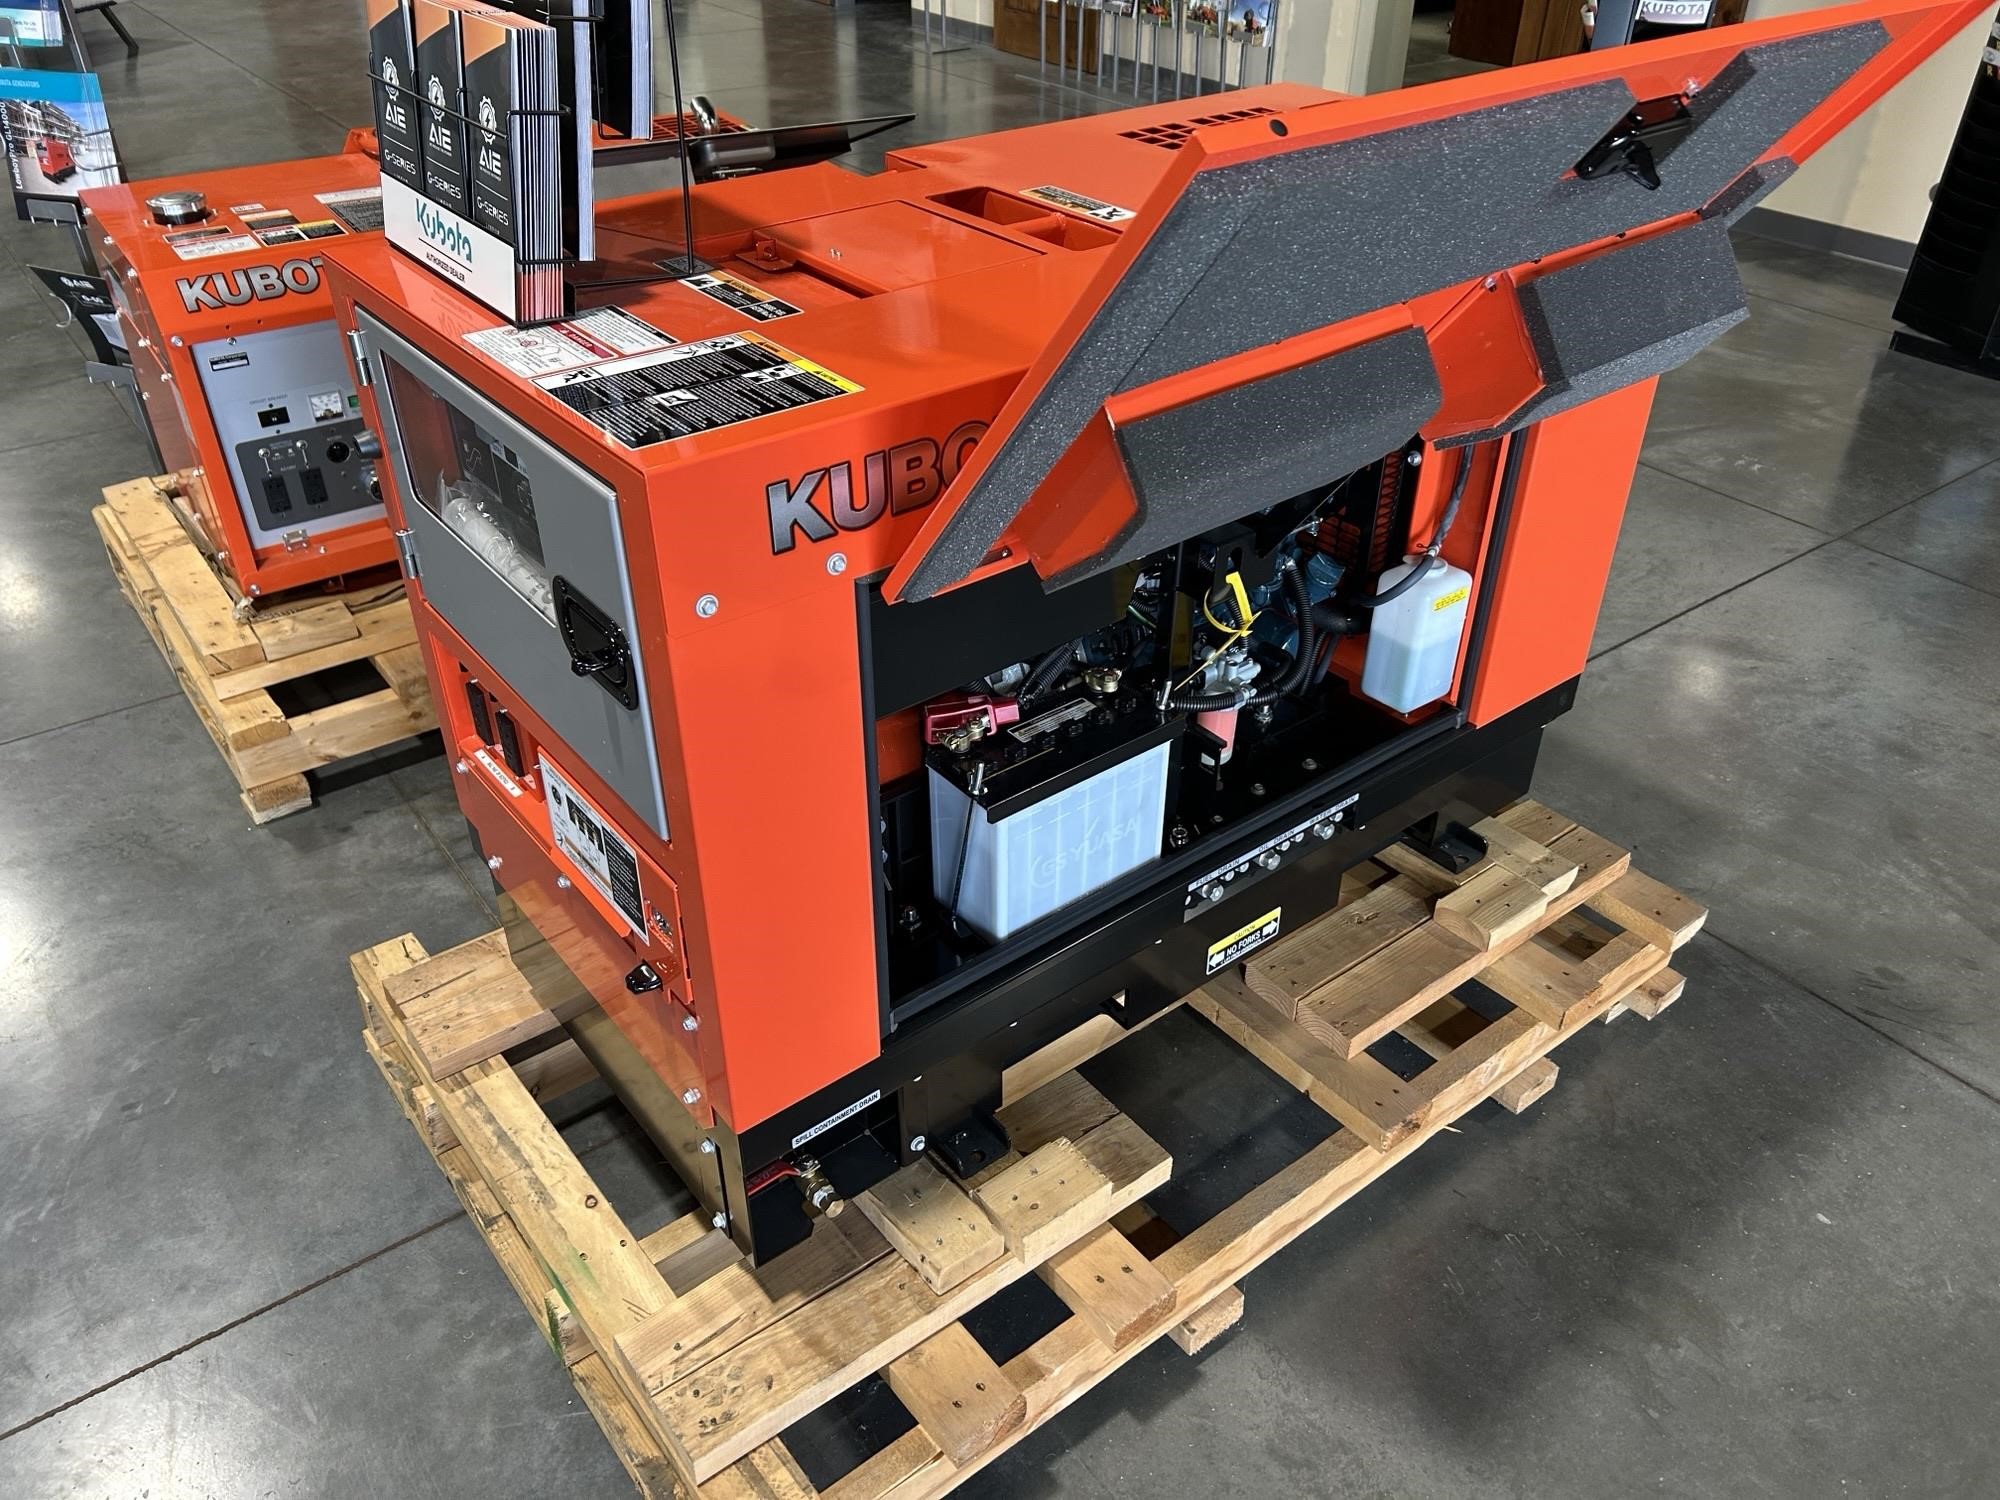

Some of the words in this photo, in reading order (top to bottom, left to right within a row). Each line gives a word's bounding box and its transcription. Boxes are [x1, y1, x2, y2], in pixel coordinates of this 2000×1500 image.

[1641, 1, 1706, 16] KUBOTA
[384, 149, 417, 175] G-SERIES
[426, 171, 462, 199] G-SERIES
[476, 196, 509, 226] G-SERIES
[415, 197, 473, 263] Kubota
[176, 256, 324, 314] KUBO
[449, 266, 466, 282] DEALER
[1195, 874, 1214, 887] FUEL
[1217, 859, 1241, 875] DRAIN
[1258, 843, 1269, 853] OIL
[1273, 829, 1296, 844] DRAIN
[1226, 944, 1238, 957] NO
[1238, 930, 1261, 950] FORKS
[1234, 924, 1257, 941] CAUTION
[794, 1131, 814, 1146] SPILL
[813, 1105, 859, 1135] CONTAINMENT
[858, 1092, 879, 1109] DRAIN
